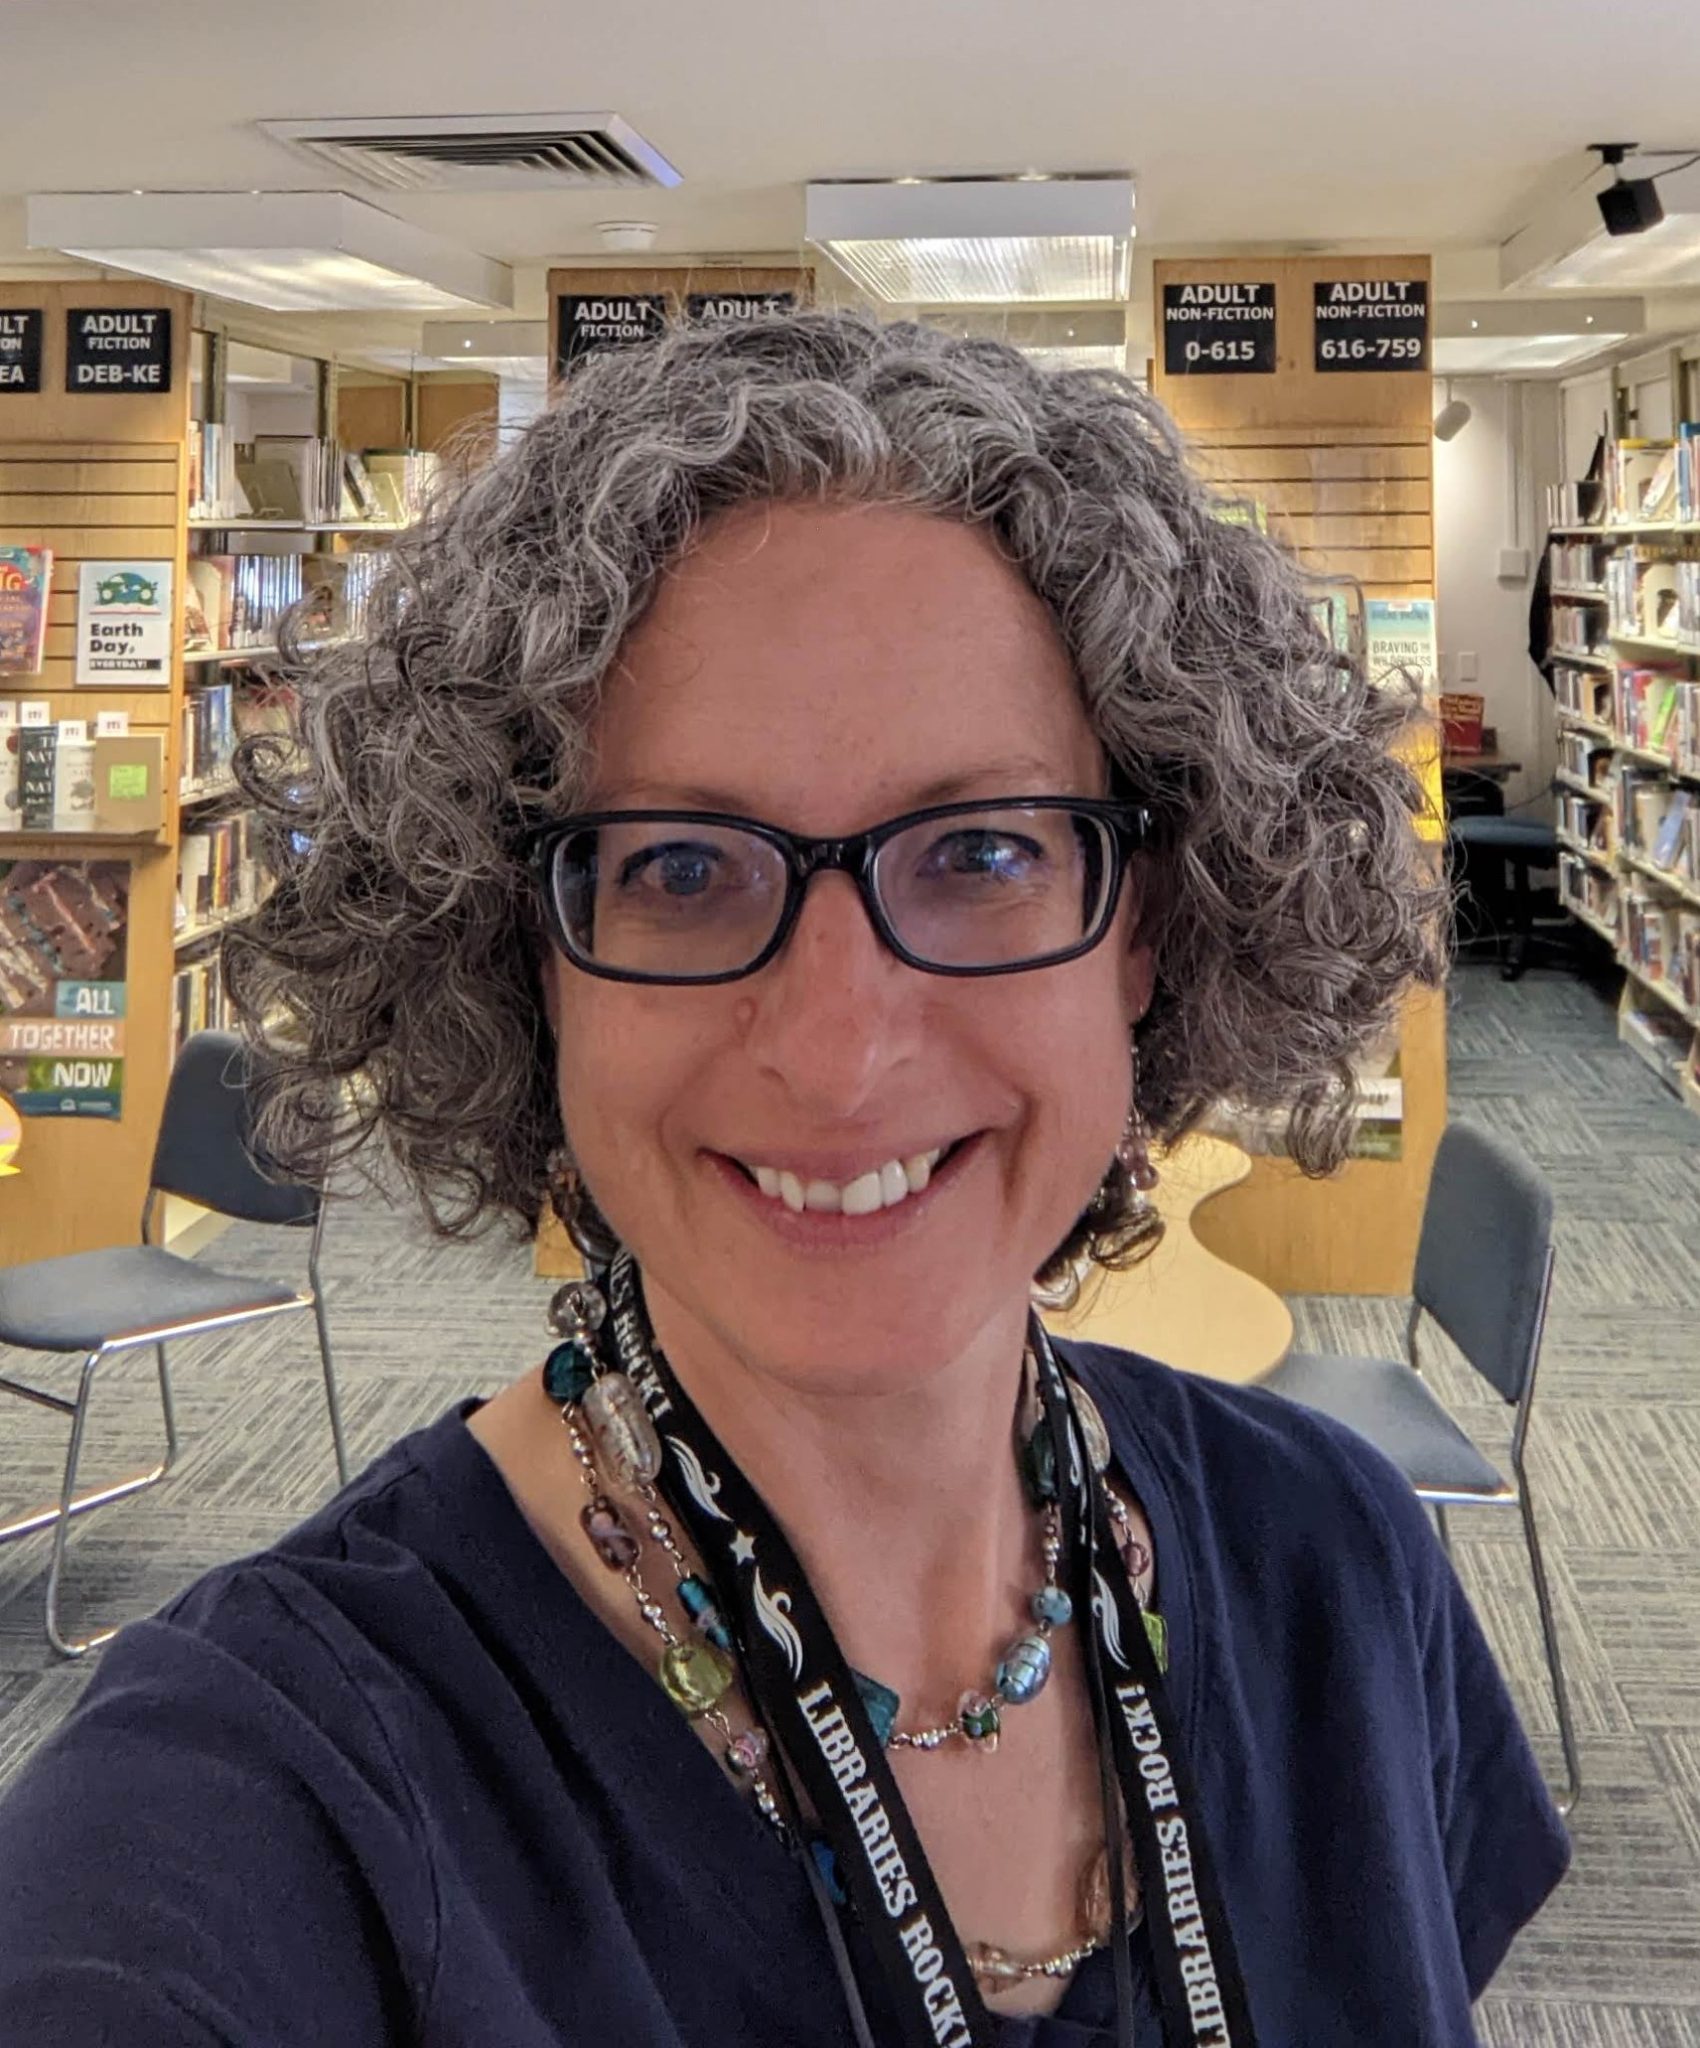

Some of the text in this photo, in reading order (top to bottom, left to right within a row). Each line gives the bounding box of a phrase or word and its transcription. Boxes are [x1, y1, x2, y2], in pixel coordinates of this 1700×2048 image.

[1180, 284, 1260, 304] ADULT
[1330, 281, 1410, 302] ADULT
[574, 301, 651, 321] ADULT
[700, 300, 779, 321] ADULT
[1166, 306, 1274, 321] NON-FICTION
[1316, 304, 1425, 319] NON-FICTION
[0, 315, 29, 334] LT
[82, 315, 157, 334] ADULT
[580, 323, 644, 338] FICTION
[88, 337, 150, 349] FICTION
[1185, 341, 1255, 361] 0-615
[1321, 338, 1421, 359] 616-759
[77, 364, 160, 384] DEB-KE
[90, 623, 143, 637] Earth
[1372, 641, 1418, 654] BRAVING
[75, 987, 115, 1015] ALL
[9, 1024, 116, 1051] TOGETHER
[53, 1061, 113, 1088] NOW
[1115, 1683, 1179, 1813] ROCK!
[798, 1680, 918, 1918] LIBRARIES
